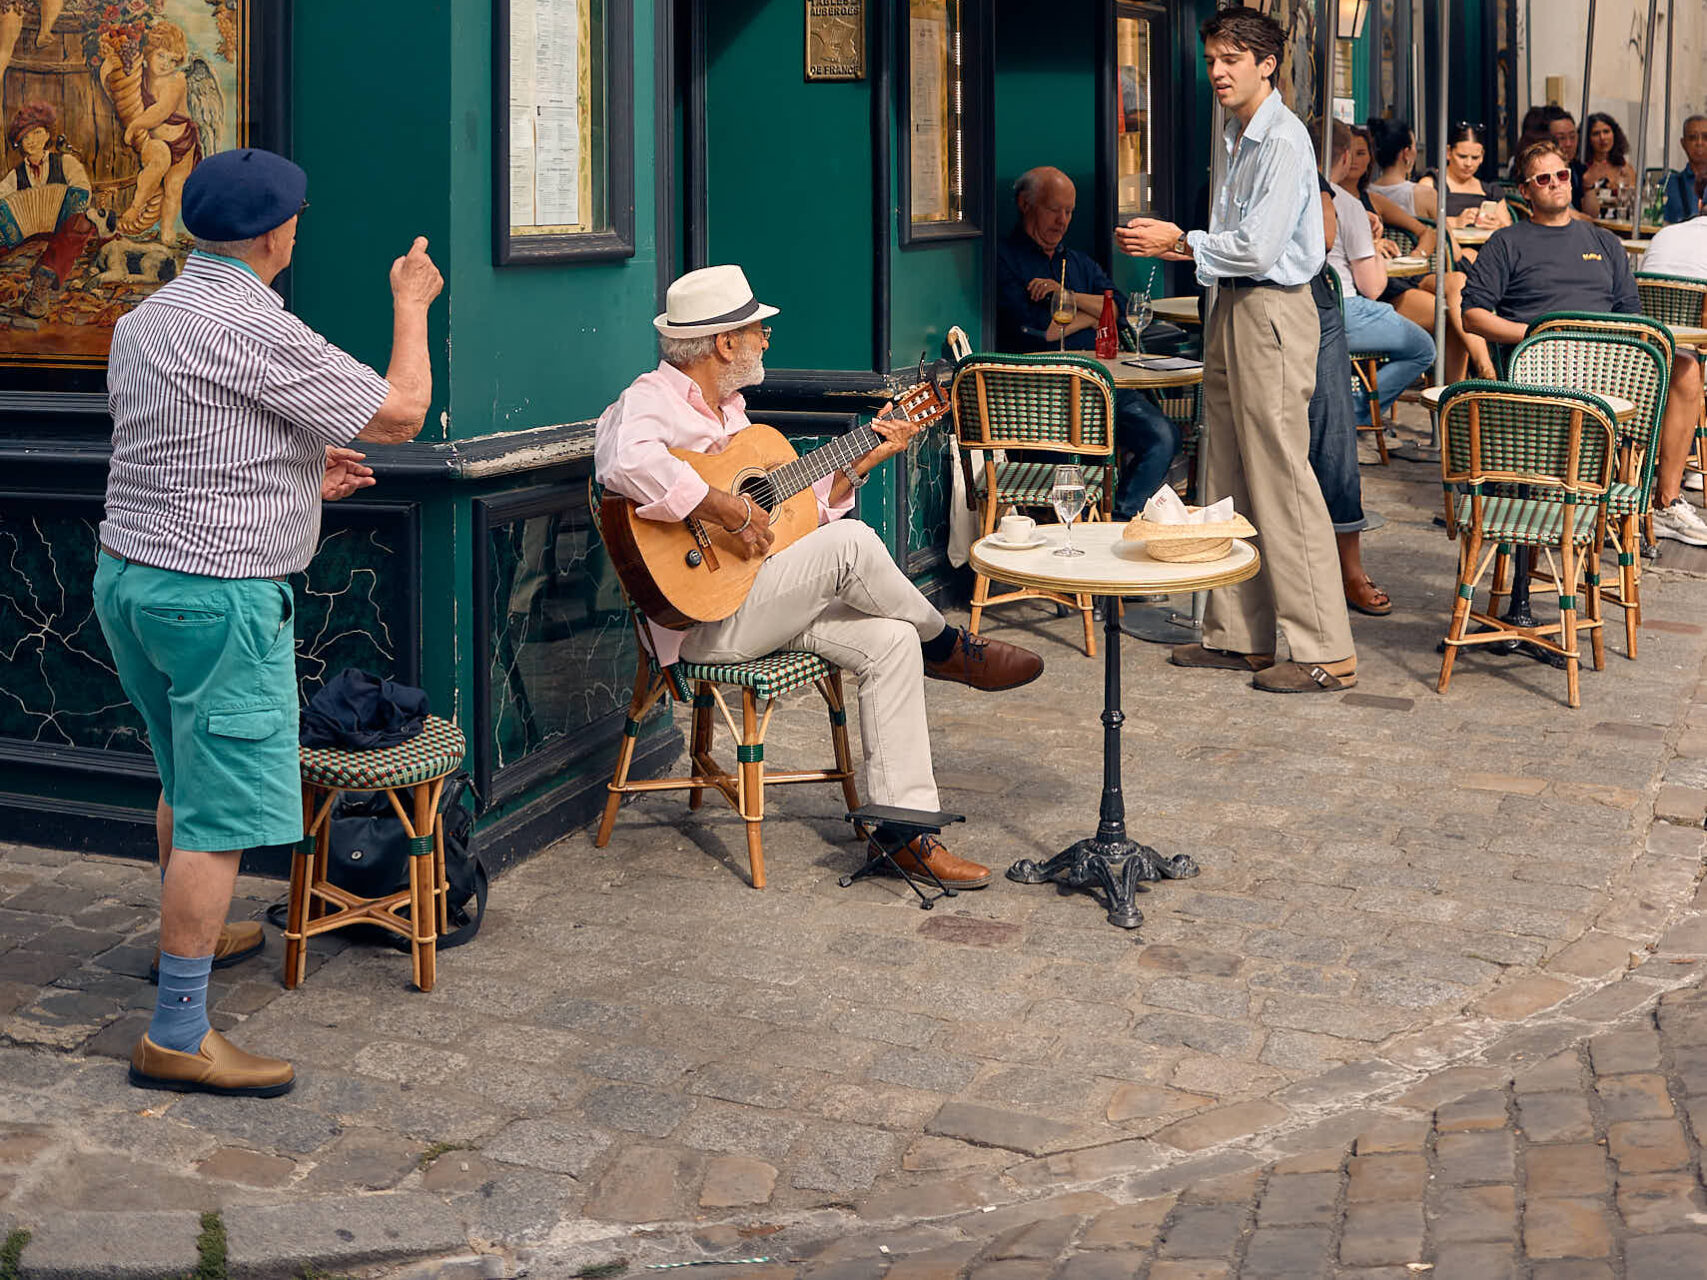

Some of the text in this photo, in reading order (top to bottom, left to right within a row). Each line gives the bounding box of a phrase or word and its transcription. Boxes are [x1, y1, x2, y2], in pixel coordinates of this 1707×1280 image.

[810, 6, 860, 17] AUBERGES
[810, 64, 860, 75] DE FRANCE
